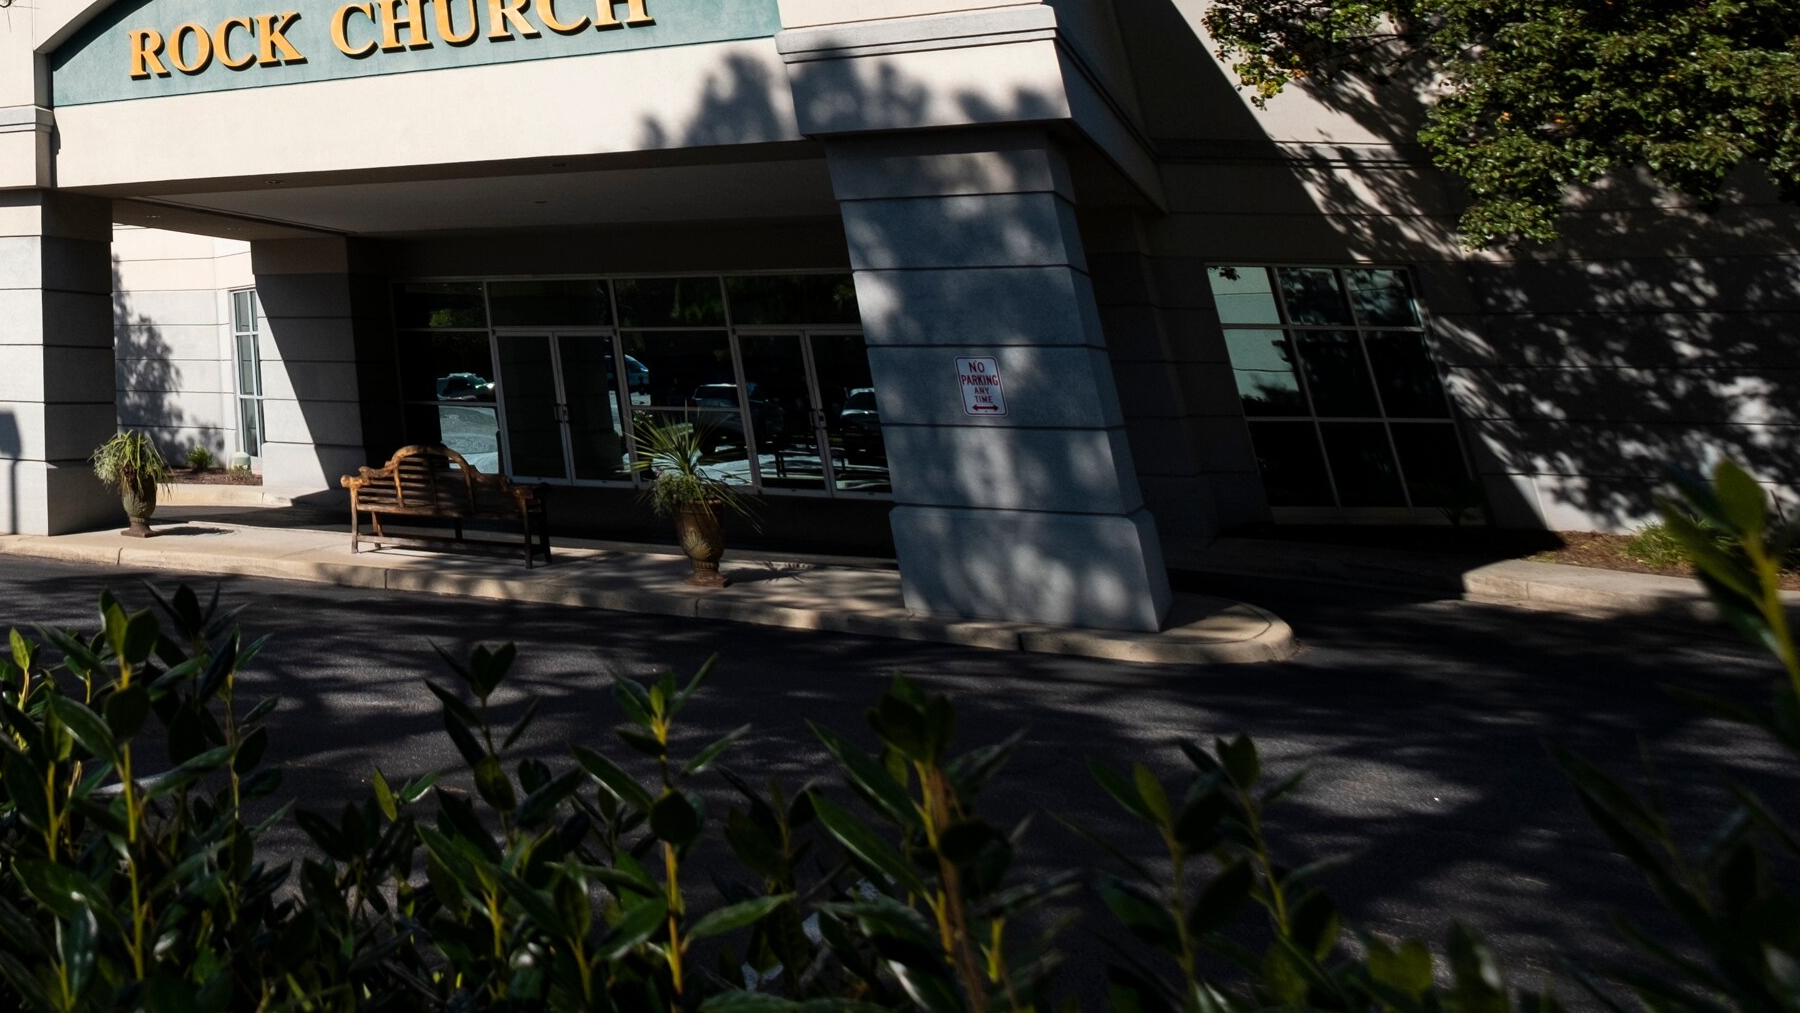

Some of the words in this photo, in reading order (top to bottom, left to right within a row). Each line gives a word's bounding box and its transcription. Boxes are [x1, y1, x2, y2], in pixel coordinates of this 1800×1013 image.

[129, 11, 307, 80] ROCK
[968, 361, 985, 373] NO
[961, 374, 999, 386] PARKING
[974, 387, 990, 395] ANY
[974, 395, 994, 404] TIME
